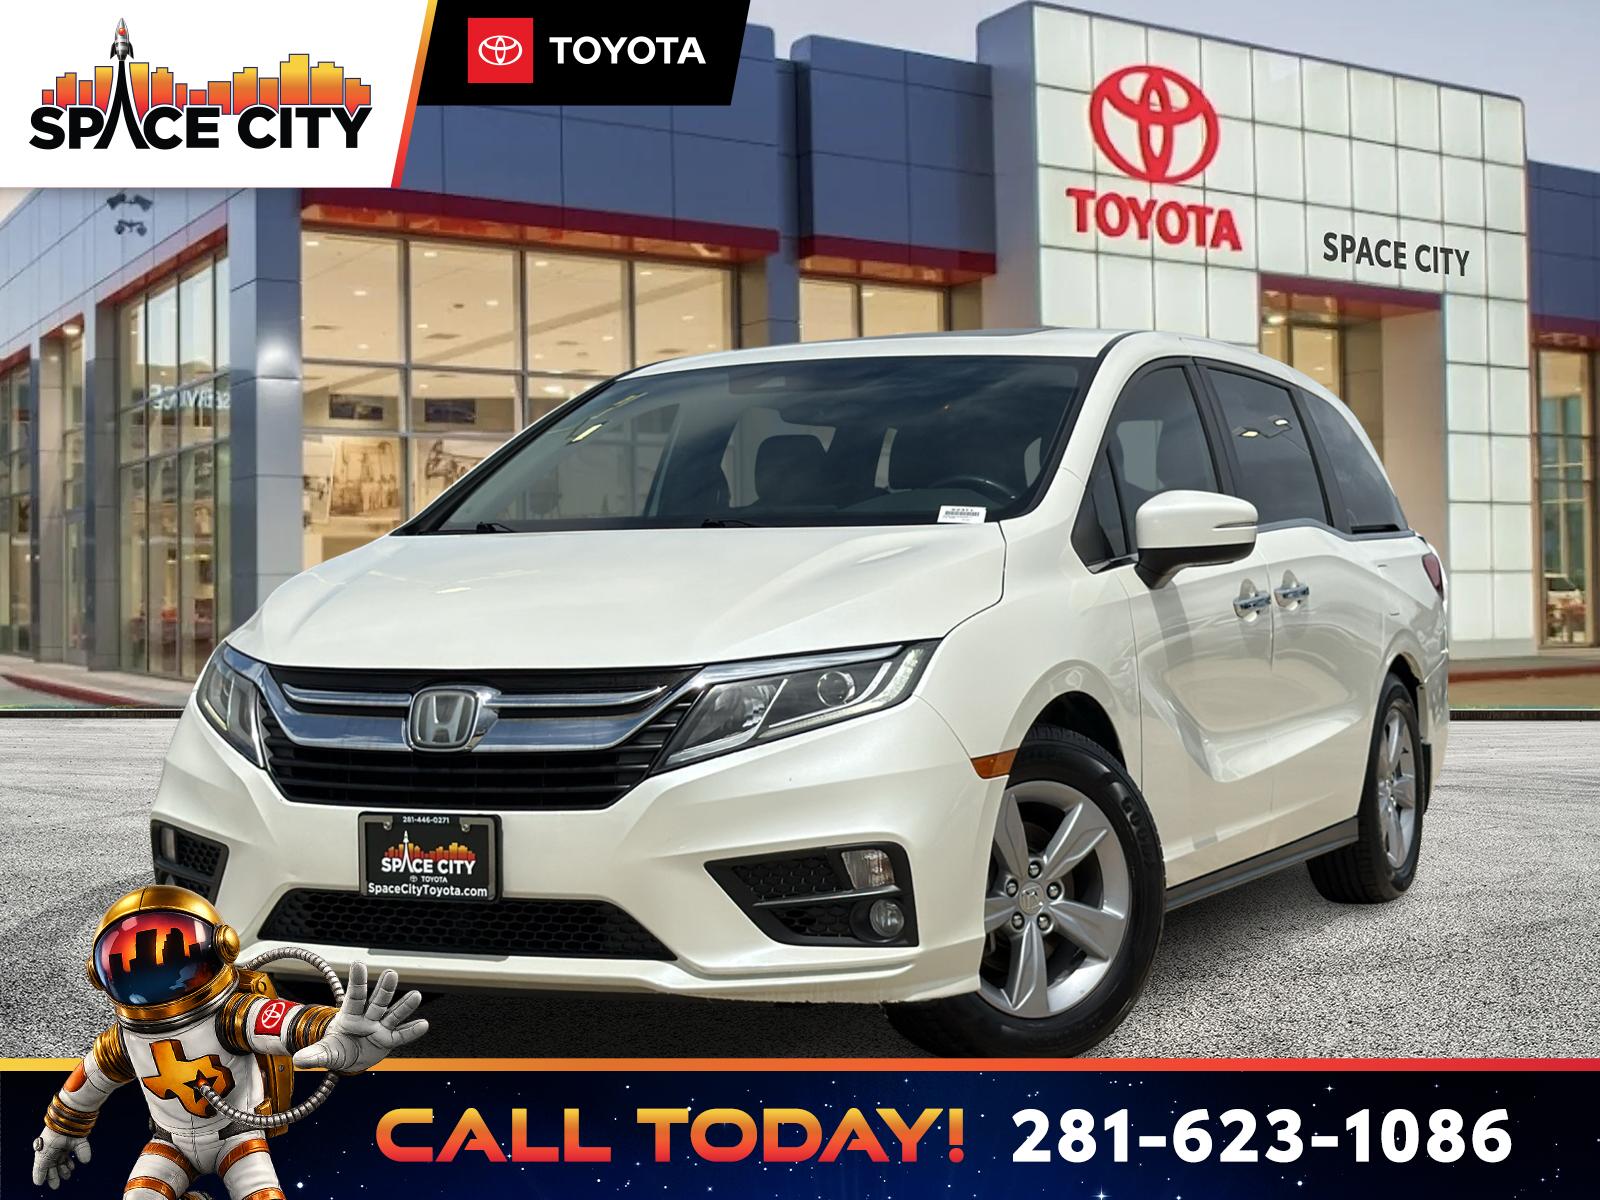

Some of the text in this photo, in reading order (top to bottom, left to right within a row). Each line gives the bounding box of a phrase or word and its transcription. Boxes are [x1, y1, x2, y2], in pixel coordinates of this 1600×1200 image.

[1066, 187, 1242, 251] TOYOTA
[1323, 231, 1470, 277] SPACE CITY
[402, 816, 450, 824] 281-446-0271
[381, 857, 476, 875] SPACE CITY
[421, 875, 448, 883] TOYOTA
[368, 882, 488, 898] SpaceCityToyota.com
